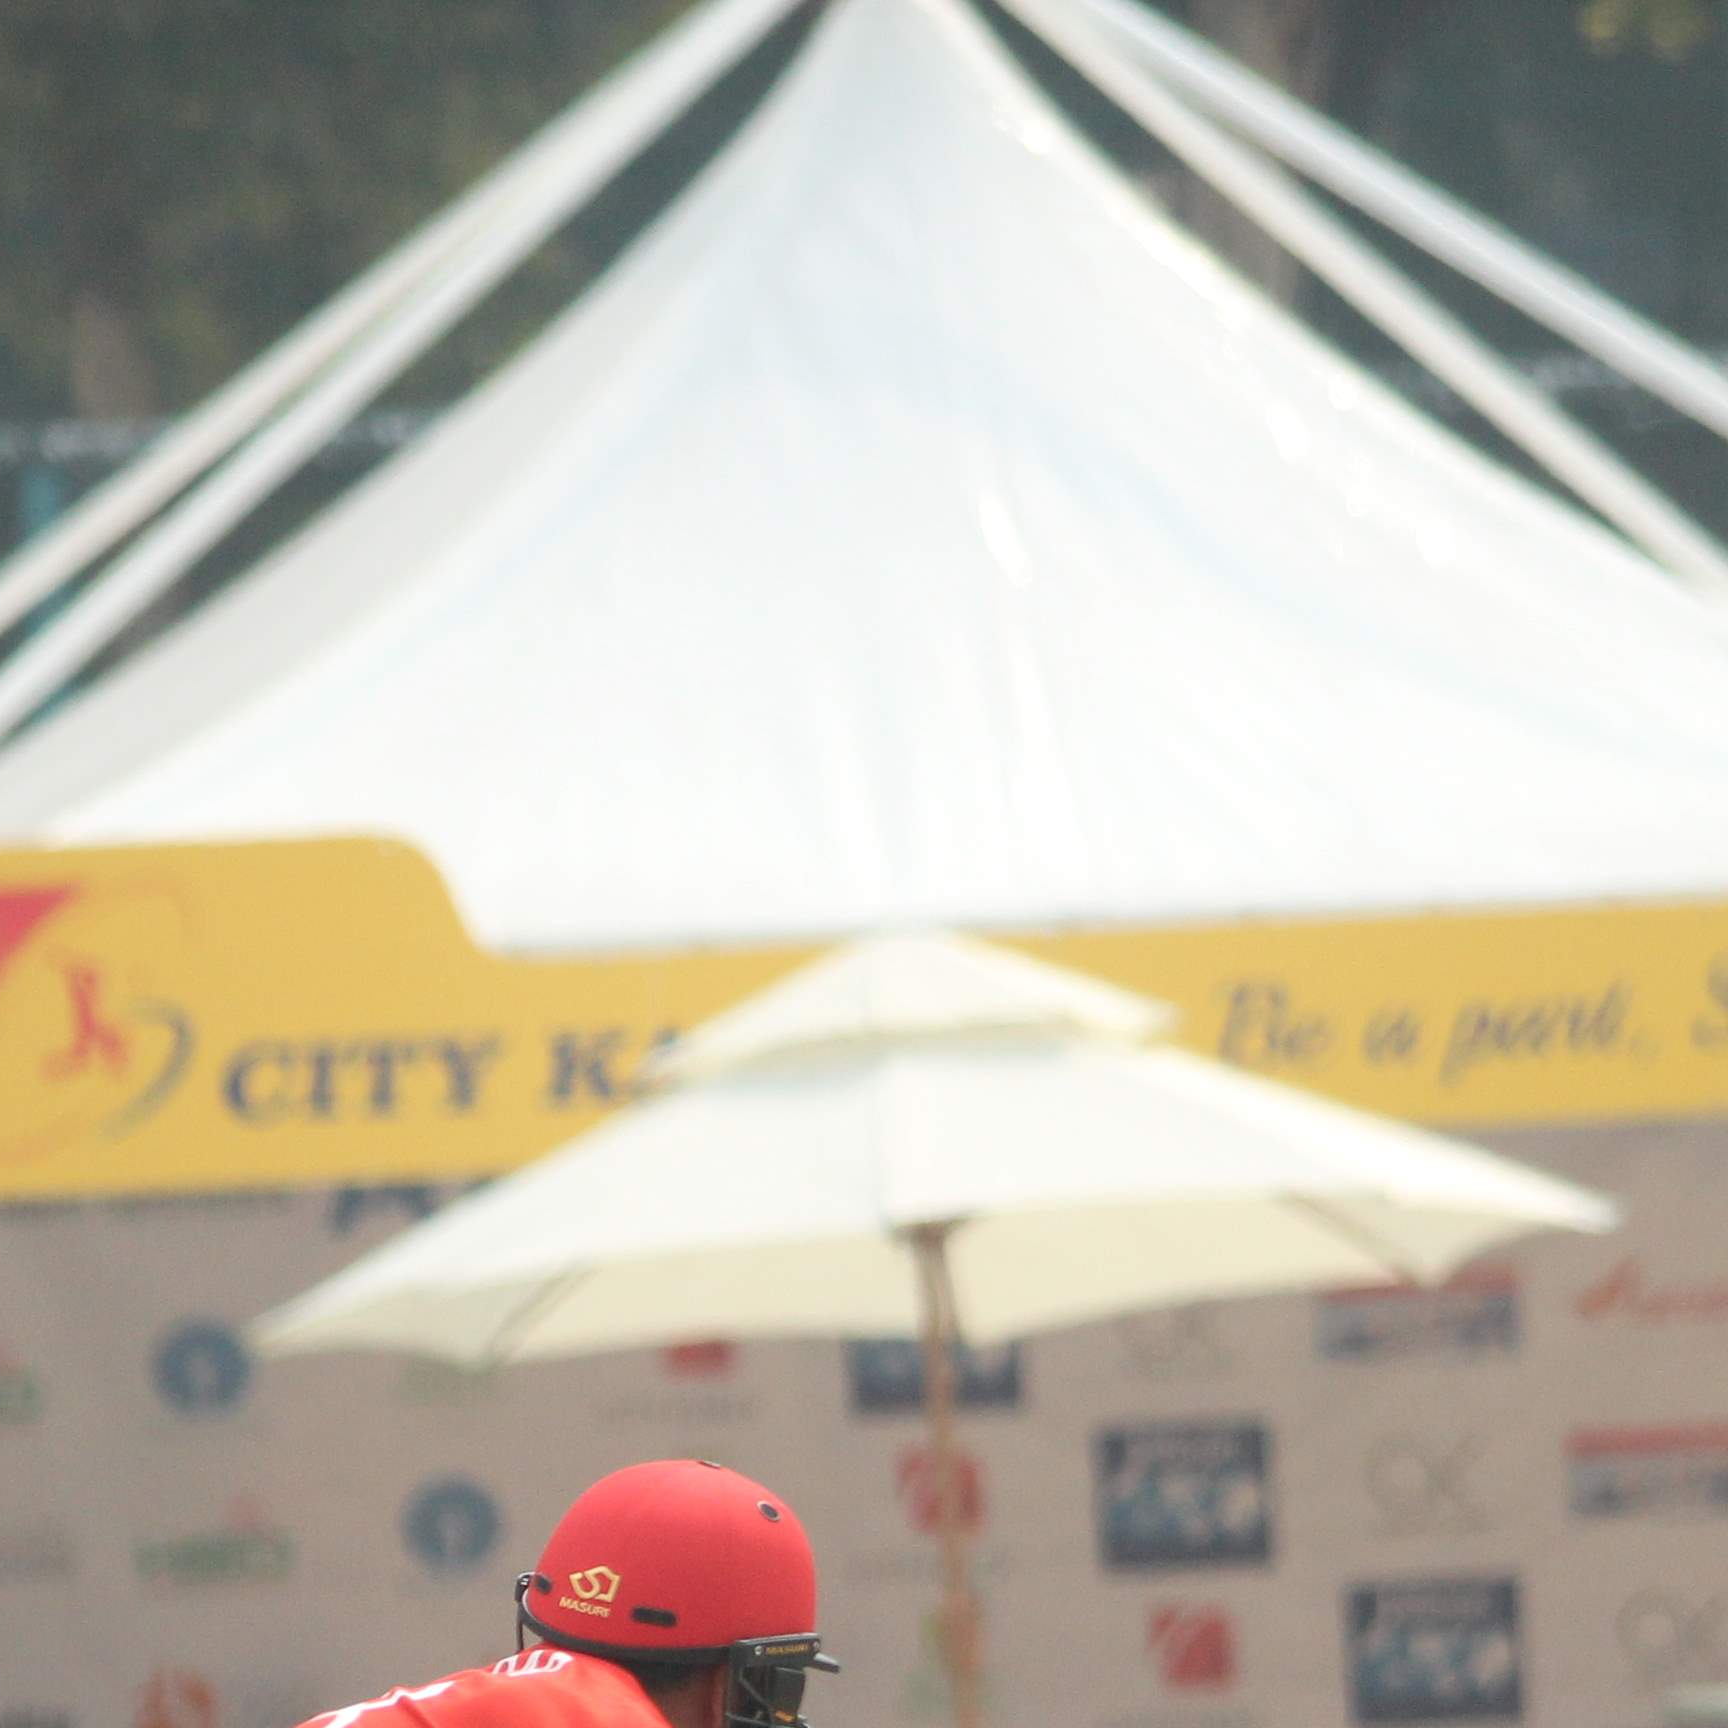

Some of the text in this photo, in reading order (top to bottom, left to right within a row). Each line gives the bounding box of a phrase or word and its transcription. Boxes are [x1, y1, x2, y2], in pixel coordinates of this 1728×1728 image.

[1218, 977, 1335, 1065] Be
[1364, 1012, 1419, 1066] a
[222, 1032, 497, 1124] CITY
